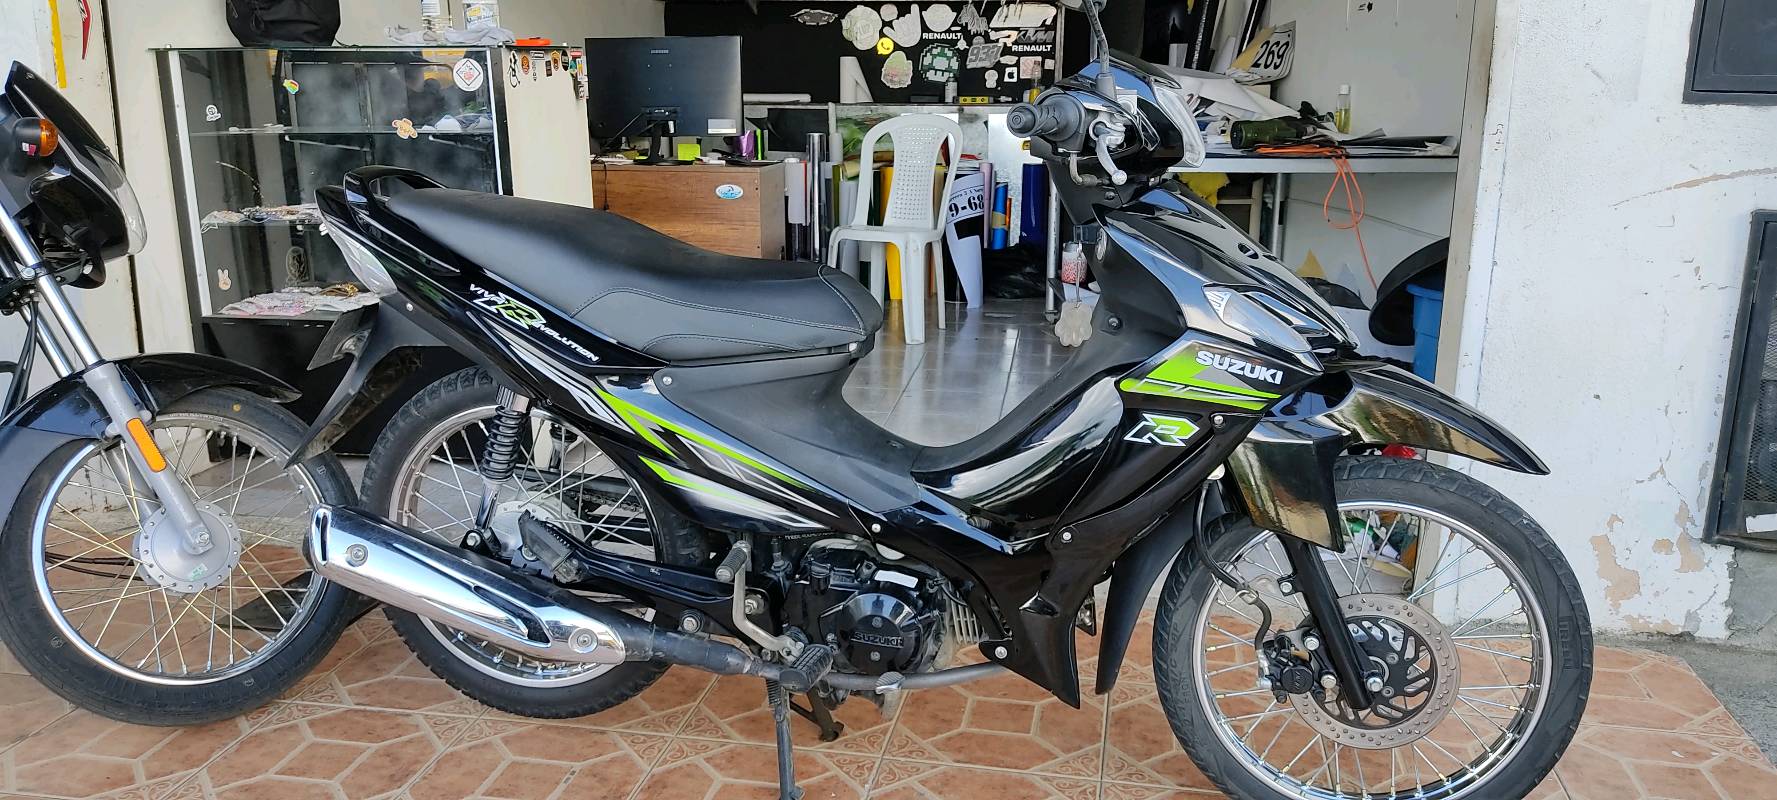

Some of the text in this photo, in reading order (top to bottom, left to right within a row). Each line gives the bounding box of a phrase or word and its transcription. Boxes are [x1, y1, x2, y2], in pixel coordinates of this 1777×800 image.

[922, 32, 962, 40] RENAULT
[1016, 27, 1055, 43] KTM
[1011, 44, 1053, 52] RENAULT
[1251, 40, 1290, 70] 269
[1195, 350, 1284, 385] SUZUKI
[1123, 411, 1200, 447] R
[852, 632, 905, 648] SUZUKI
